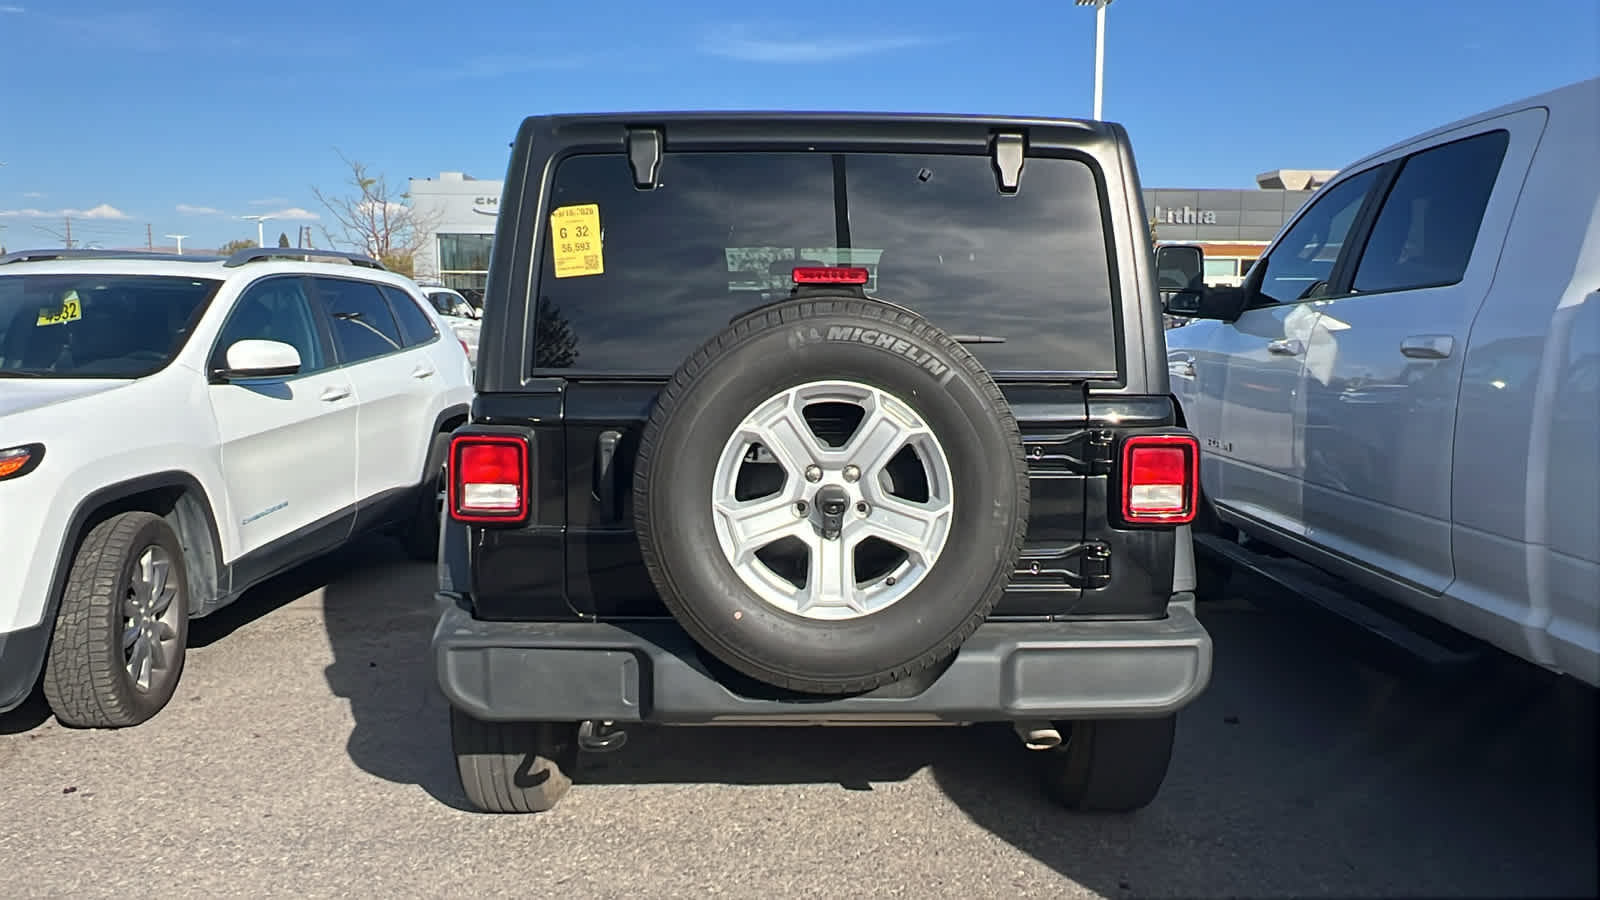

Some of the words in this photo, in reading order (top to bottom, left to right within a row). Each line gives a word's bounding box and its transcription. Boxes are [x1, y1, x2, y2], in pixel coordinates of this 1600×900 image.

[1155, 205, 1217, 225] Lithia
[559, 227, 568, 239] G
[575, 225, 589, 237] 32
[827, 325, 949, 376] MICHELIN
